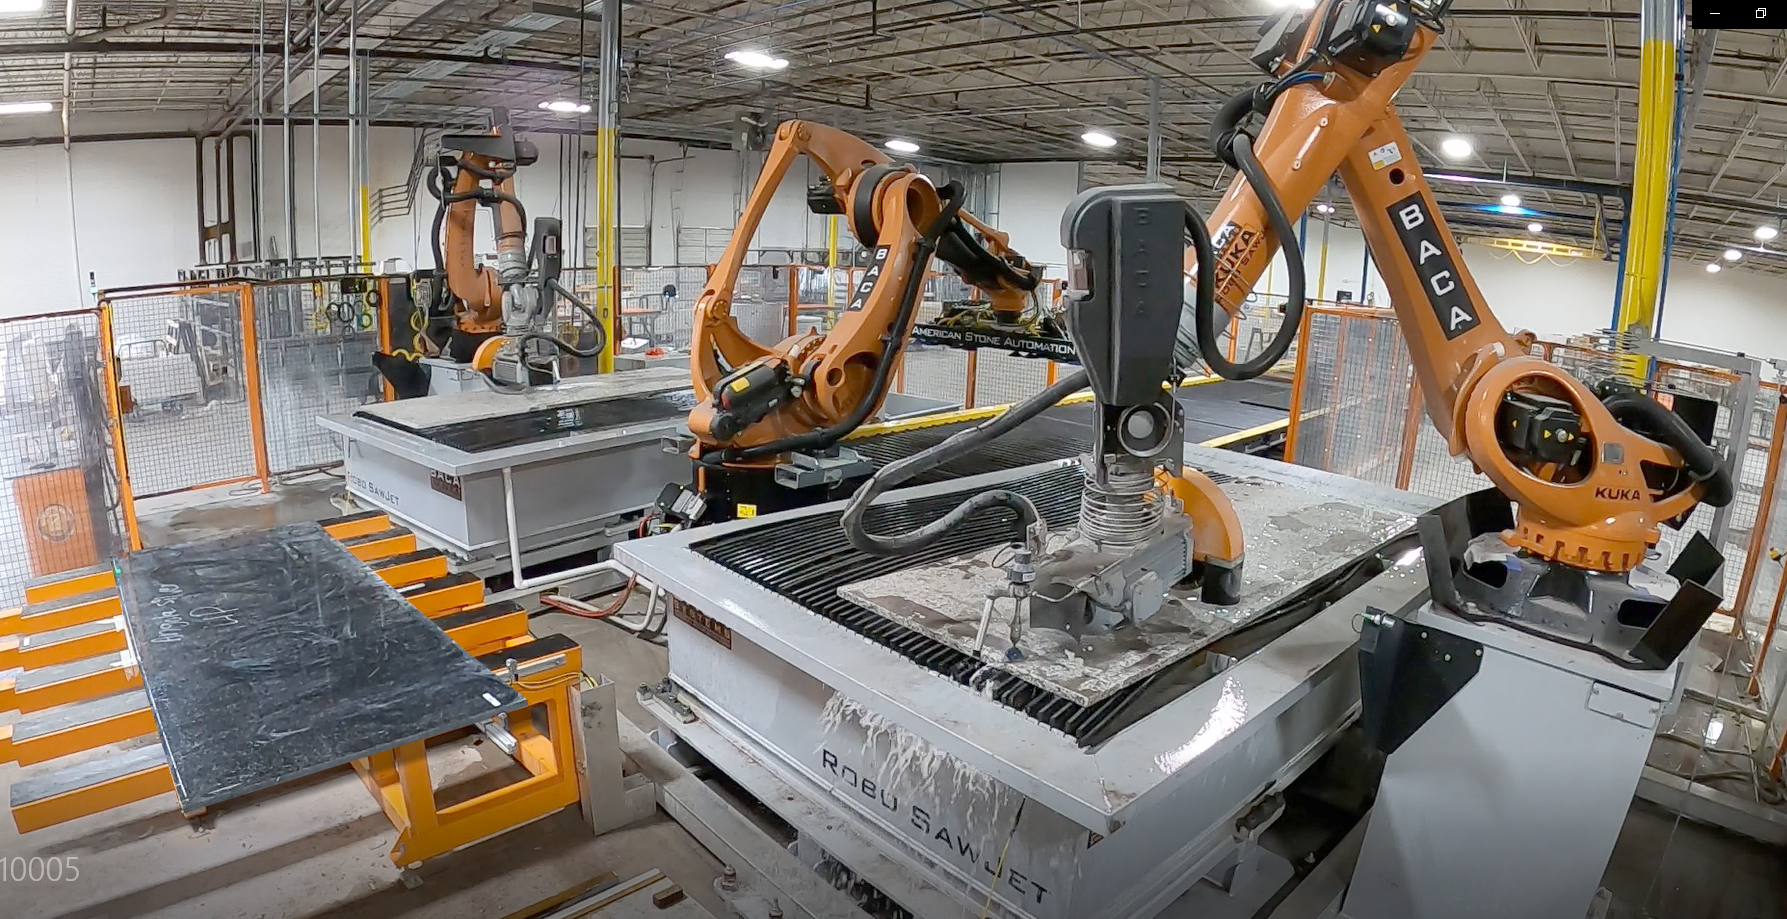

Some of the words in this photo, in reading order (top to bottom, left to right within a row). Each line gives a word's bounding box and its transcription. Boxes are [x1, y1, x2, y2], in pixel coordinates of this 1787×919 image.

[845, 248, 888, 309] BACA
[1399, 203, 1473, 331] BACA
[911, 325, 962, 340] AMERICAN
[965, 331, 1001, 346] STONE
[1003, 338, 1076, 356] AUTOMATION
[1595, 486, 1641, 501] KUKA
[822, 749, 897, 812] ROBO
[910, 804, 1051, 904] SAWJET
